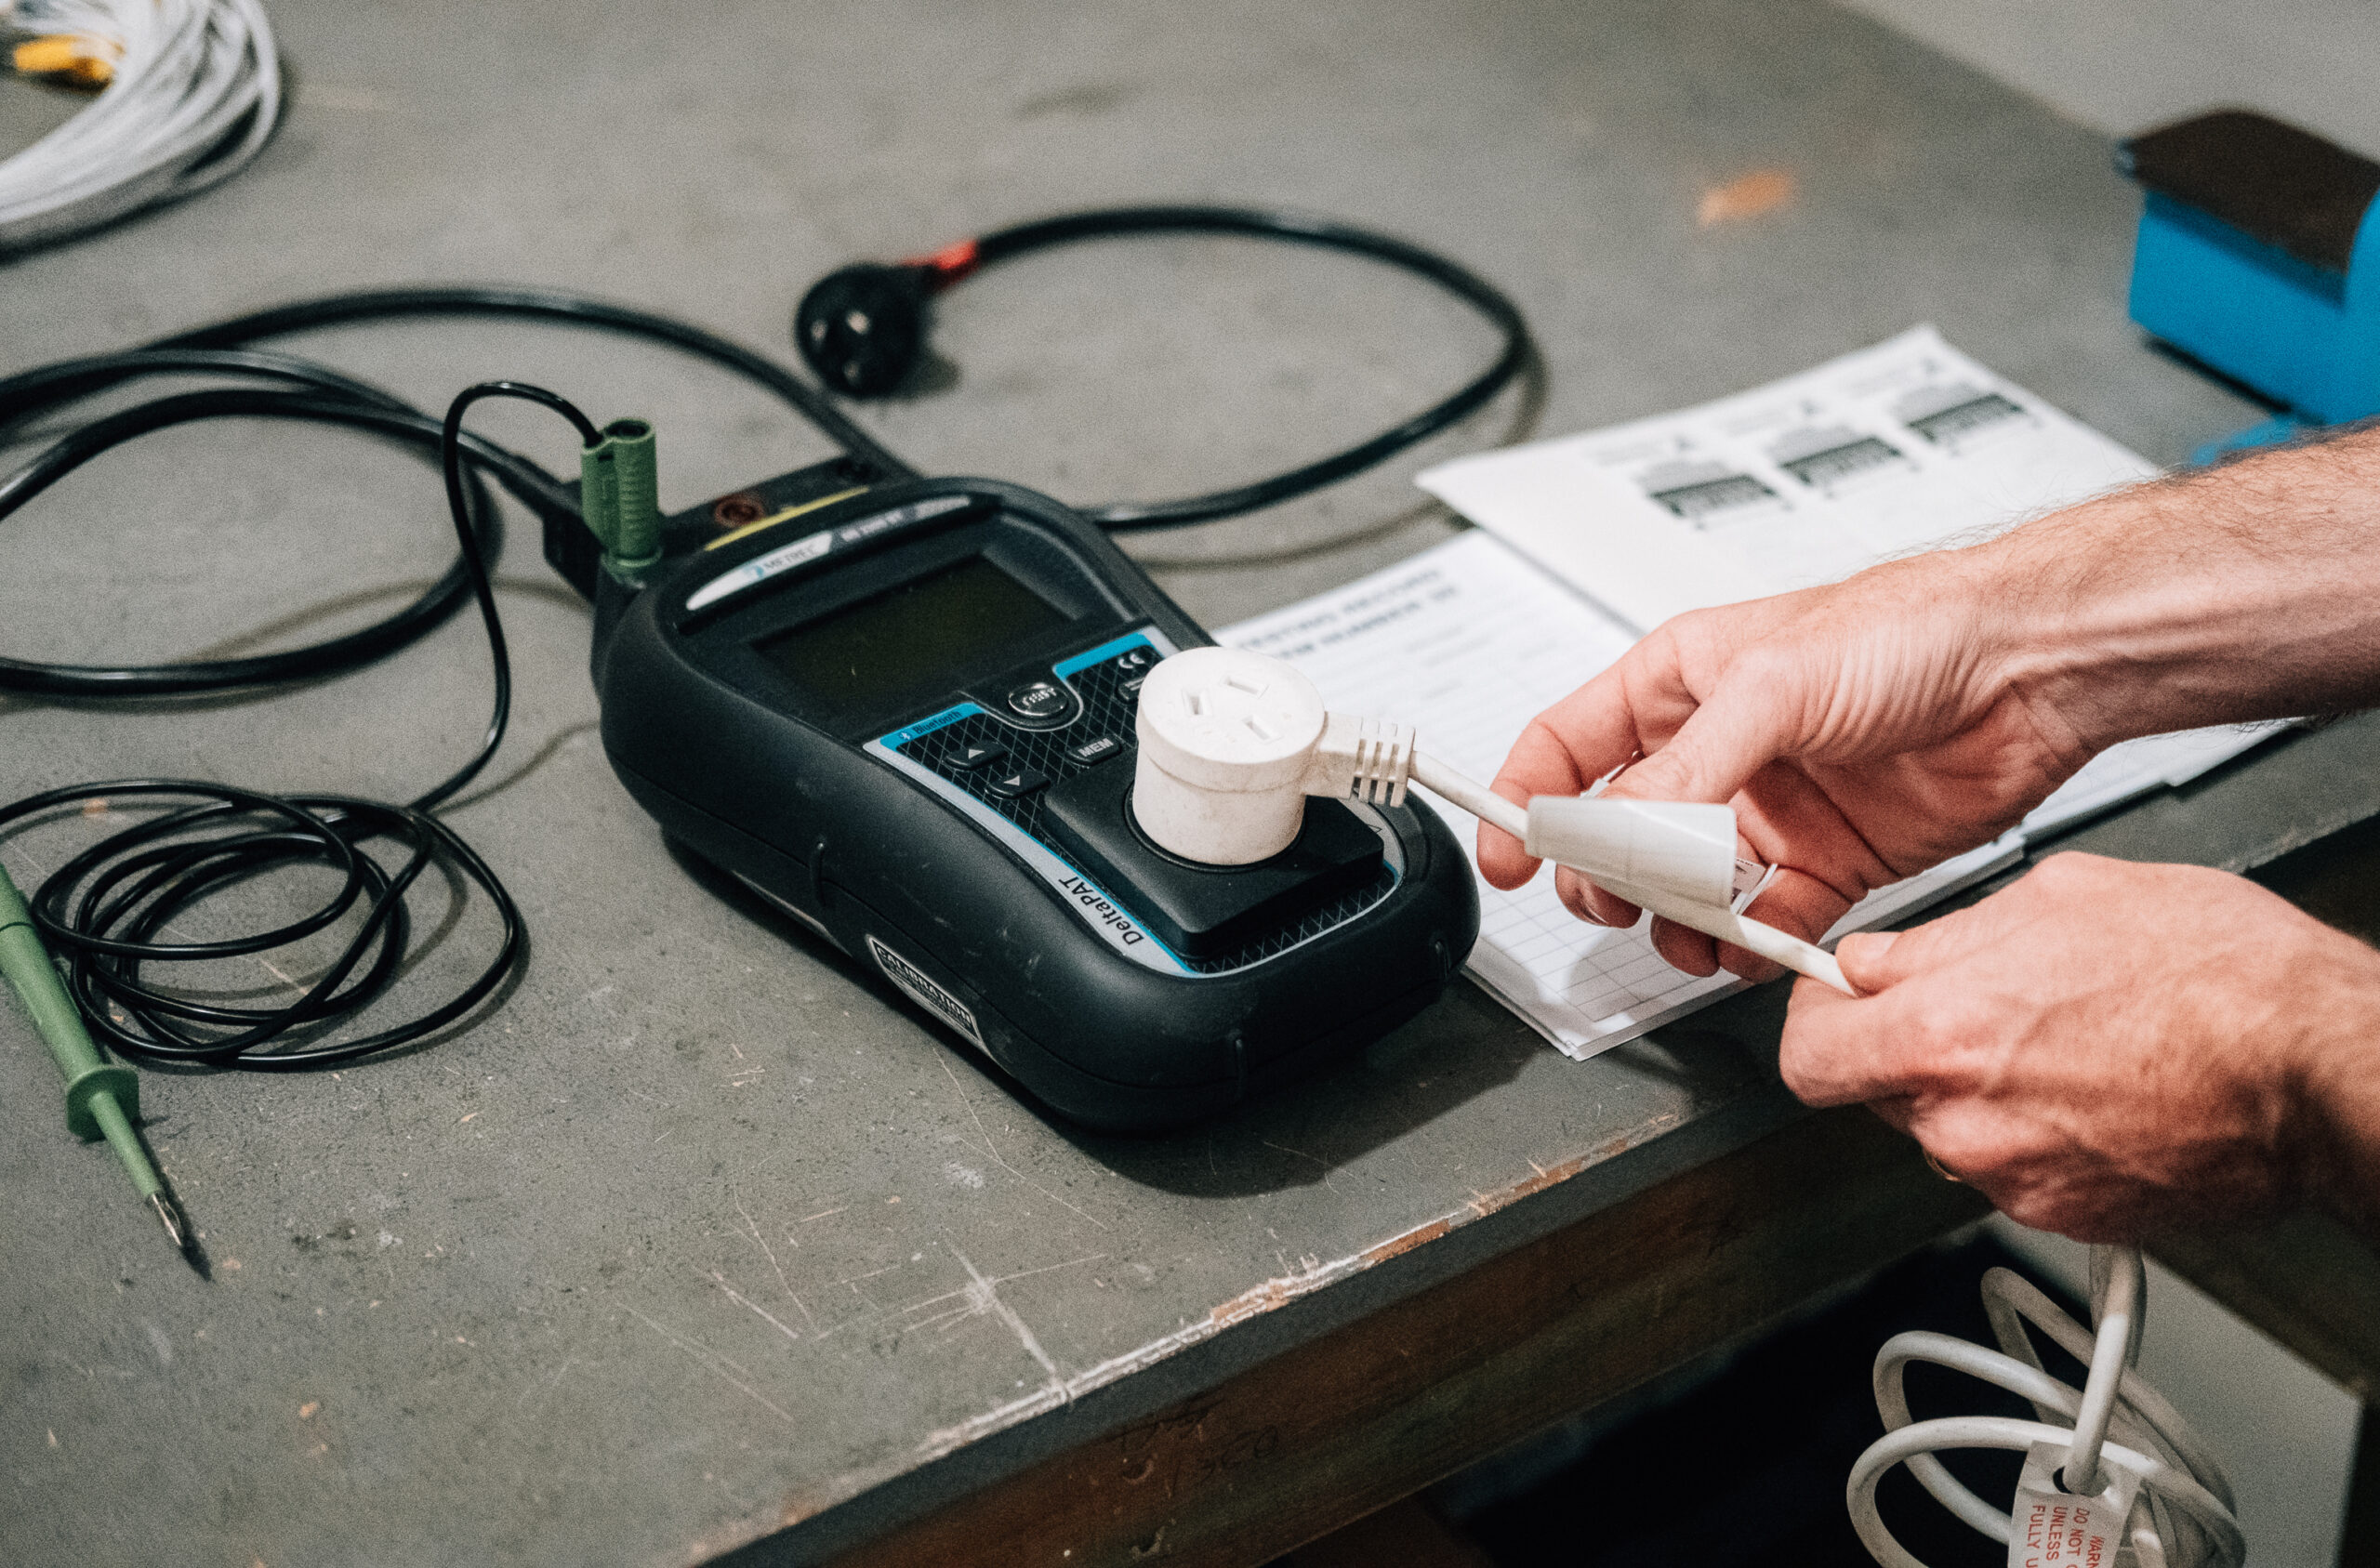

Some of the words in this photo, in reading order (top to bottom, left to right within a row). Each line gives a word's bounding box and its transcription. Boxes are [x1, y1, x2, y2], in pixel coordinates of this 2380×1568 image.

[912, 710, 962, 735] Bluetooth
[1078, 737, 1115, 758] MEM
[1058, 876, 1144, 945] DeltaPAT
[2027, 1504, 2046, 1549] FULLY
[2072, 1507, 2091, 1524] DO
[2045, 1506, 2068, 1561] UNLESS
[2067, 1527, 2084, 1556] NOT
